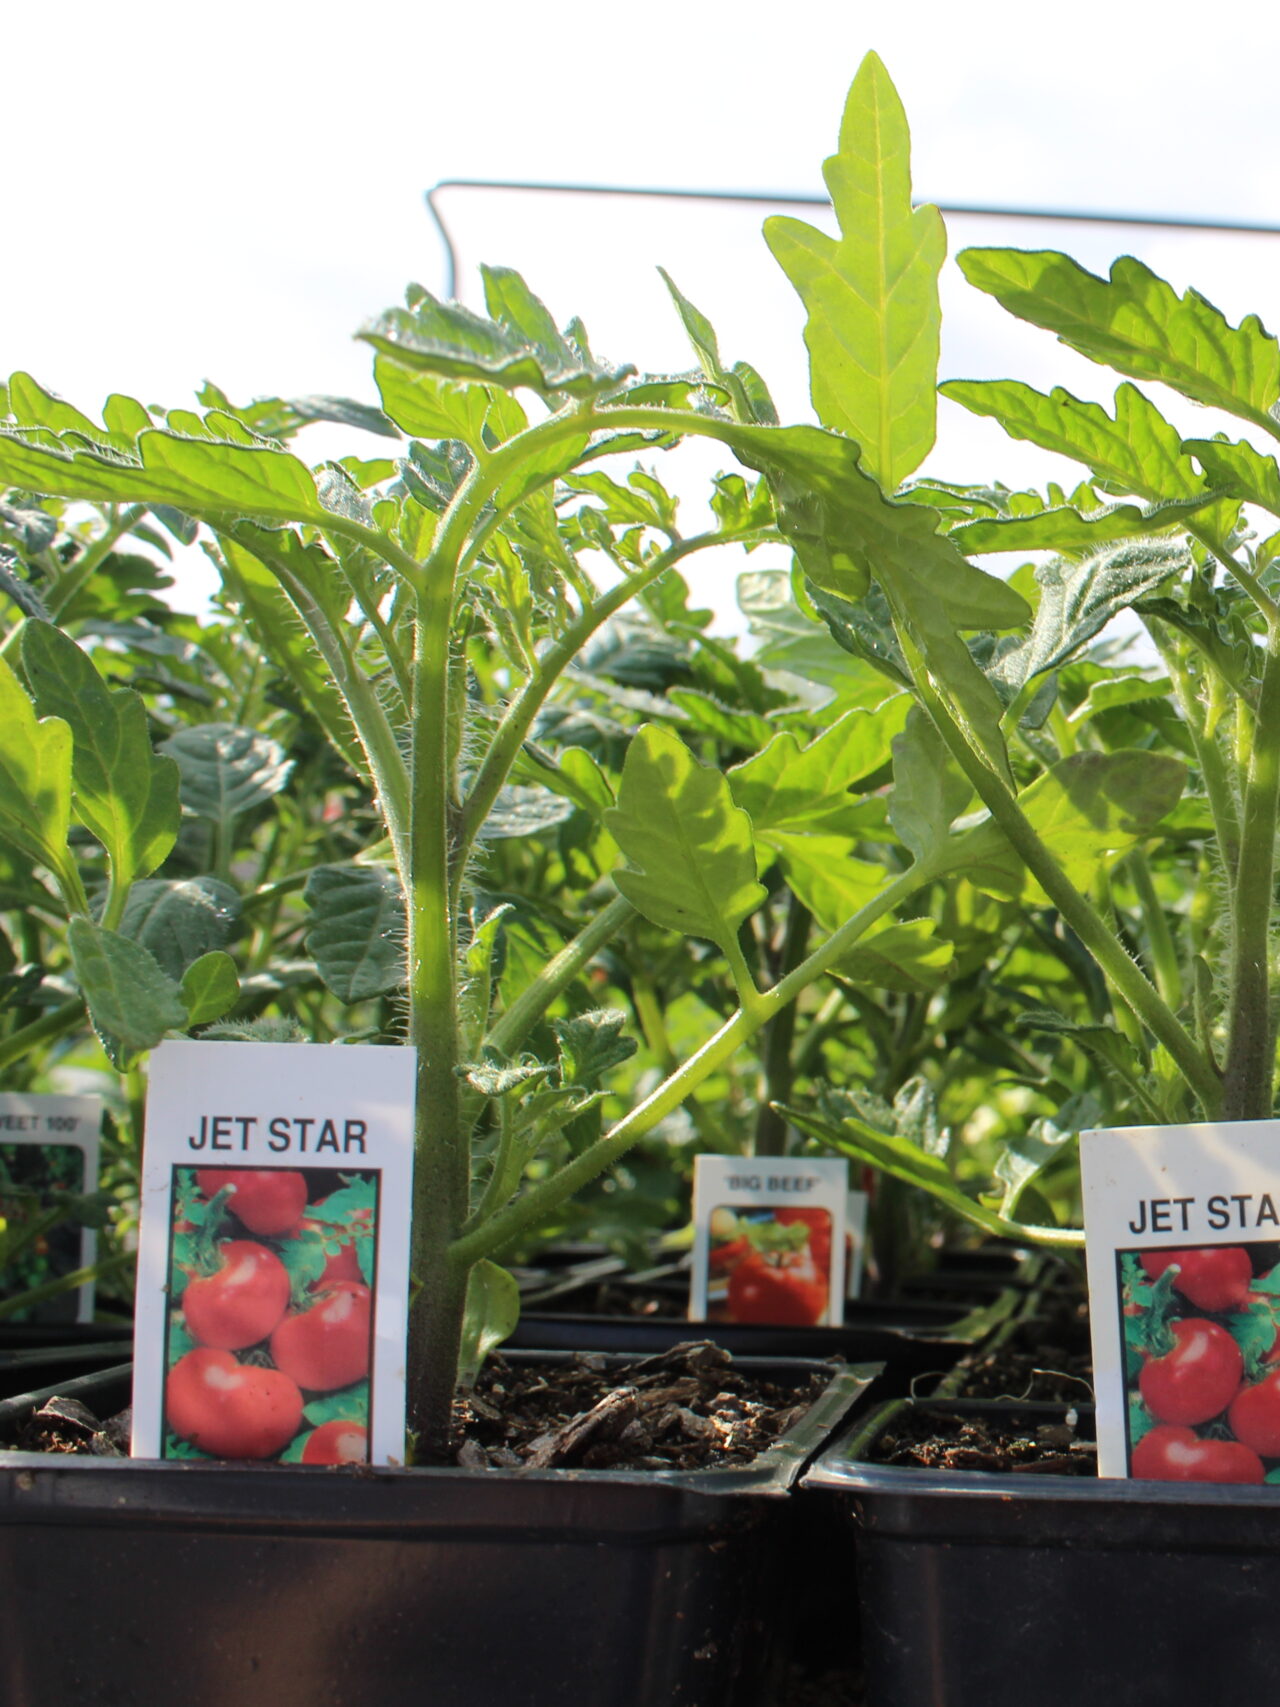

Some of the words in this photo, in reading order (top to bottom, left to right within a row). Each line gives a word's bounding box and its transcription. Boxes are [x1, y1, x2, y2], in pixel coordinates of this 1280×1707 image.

[0, 1115, 40, 1131] EET
[189, 1116, 257, 1150] JET
[268, 1117, 367, 1153] STAR
[1129, 1198, 1195, 1234] JET
